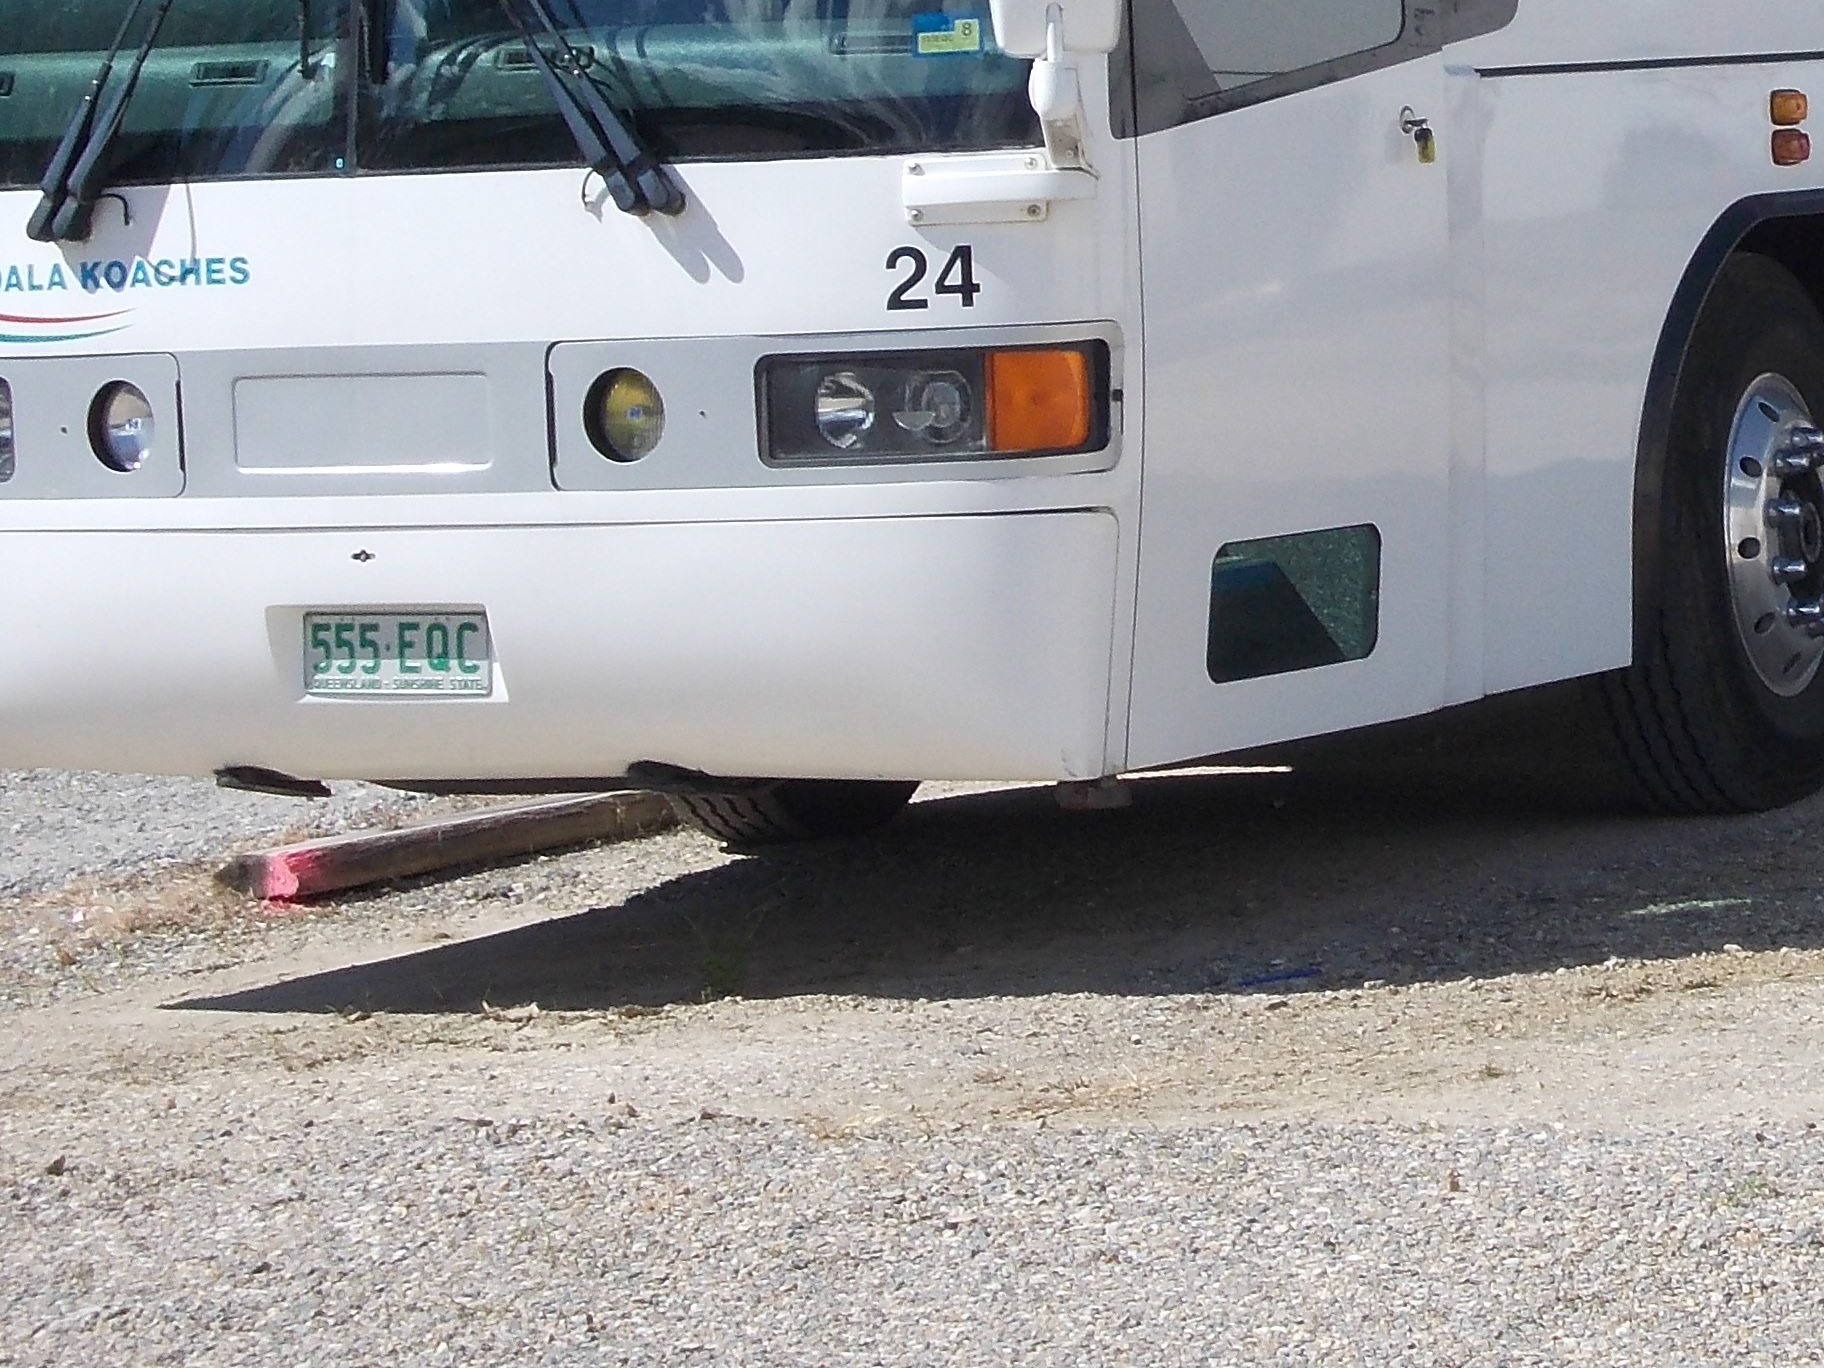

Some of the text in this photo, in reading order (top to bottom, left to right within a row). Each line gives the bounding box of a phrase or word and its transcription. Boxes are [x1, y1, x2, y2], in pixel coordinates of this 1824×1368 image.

[961, 22, 972, 37] 8
[0, 257, 250, 292] ALA KOACHES
[886, 245, 981, 311] 24
[311, 677, 381, 690] QUEENSLAND
[392, 677, 444, 690] SUNSHINE
[450, 677, 482, 690] STATE
